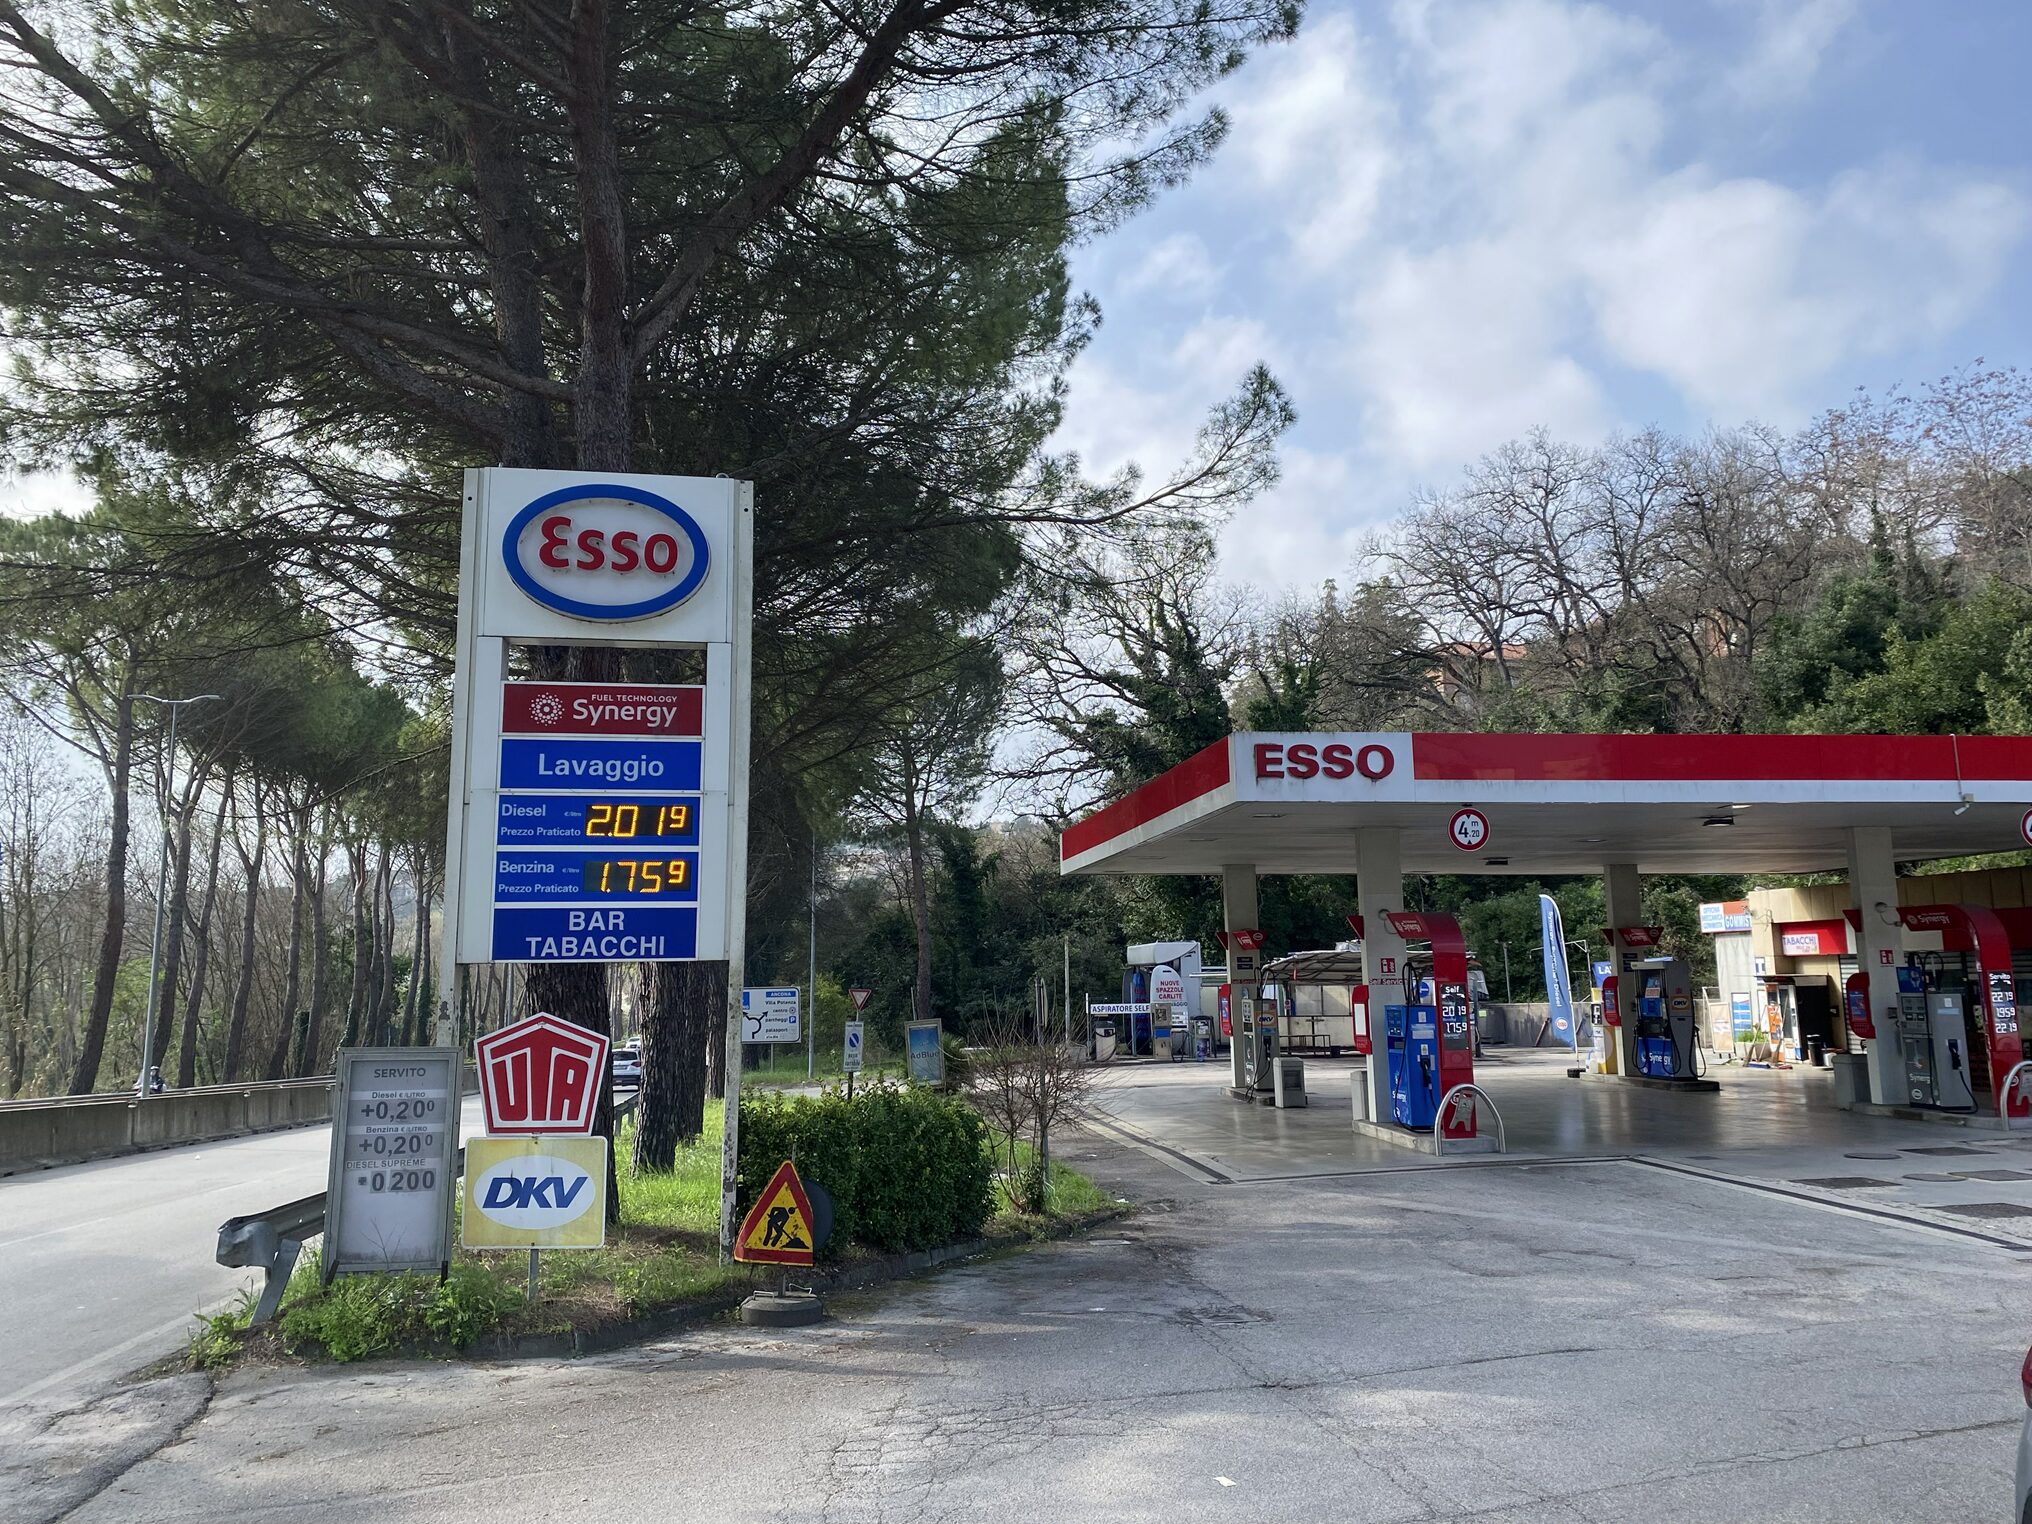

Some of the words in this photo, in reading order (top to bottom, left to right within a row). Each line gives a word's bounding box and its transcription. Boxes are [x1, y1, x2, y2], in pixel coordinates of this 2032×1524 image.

[572, 699, 677, 727] Synergy
[538, 753, 664, 781] Lavaggio
[1254, 743, 1395, 780] ESSO
[502, 804, 546, 817] Diesel
[500, 827, 534, 836] Prezzo
[536, 827, 581, 837] Praticato
[499, 860, 555, 873] Benzina
[498, 884, 530, 893] Prezzo
[531, 884, 579, 893] Praticato
[568, 911, 625, 931] BAR
[1917, 915, 1950, 925] Synergy
[525, 936, 665, 957] TABACCHI
[1782, 936, 1816, 945] TABACCHI
[1445, 985, 1460, 993] Self
[1553, 983, 1563, 1007] Diesel
[1092, 1005, 1133, 1013] ASPIRATORE
[1134, 1004, 1149, 1012] SELF
[1649, 1052, 1672, 1065] Synegy
[373, 1067, 426, 1078] SERVITO
[490, 1026, 593, 1121] UTA
[372, 1091, 397, 1099] Diesel
[365, 1126, 399, 1134] Benzina
[346, 1160, 379, 1169] DIESEL
[381, 1158, 426, 1168] SUPREME
[482, 1176, 589, 1209] DKV
